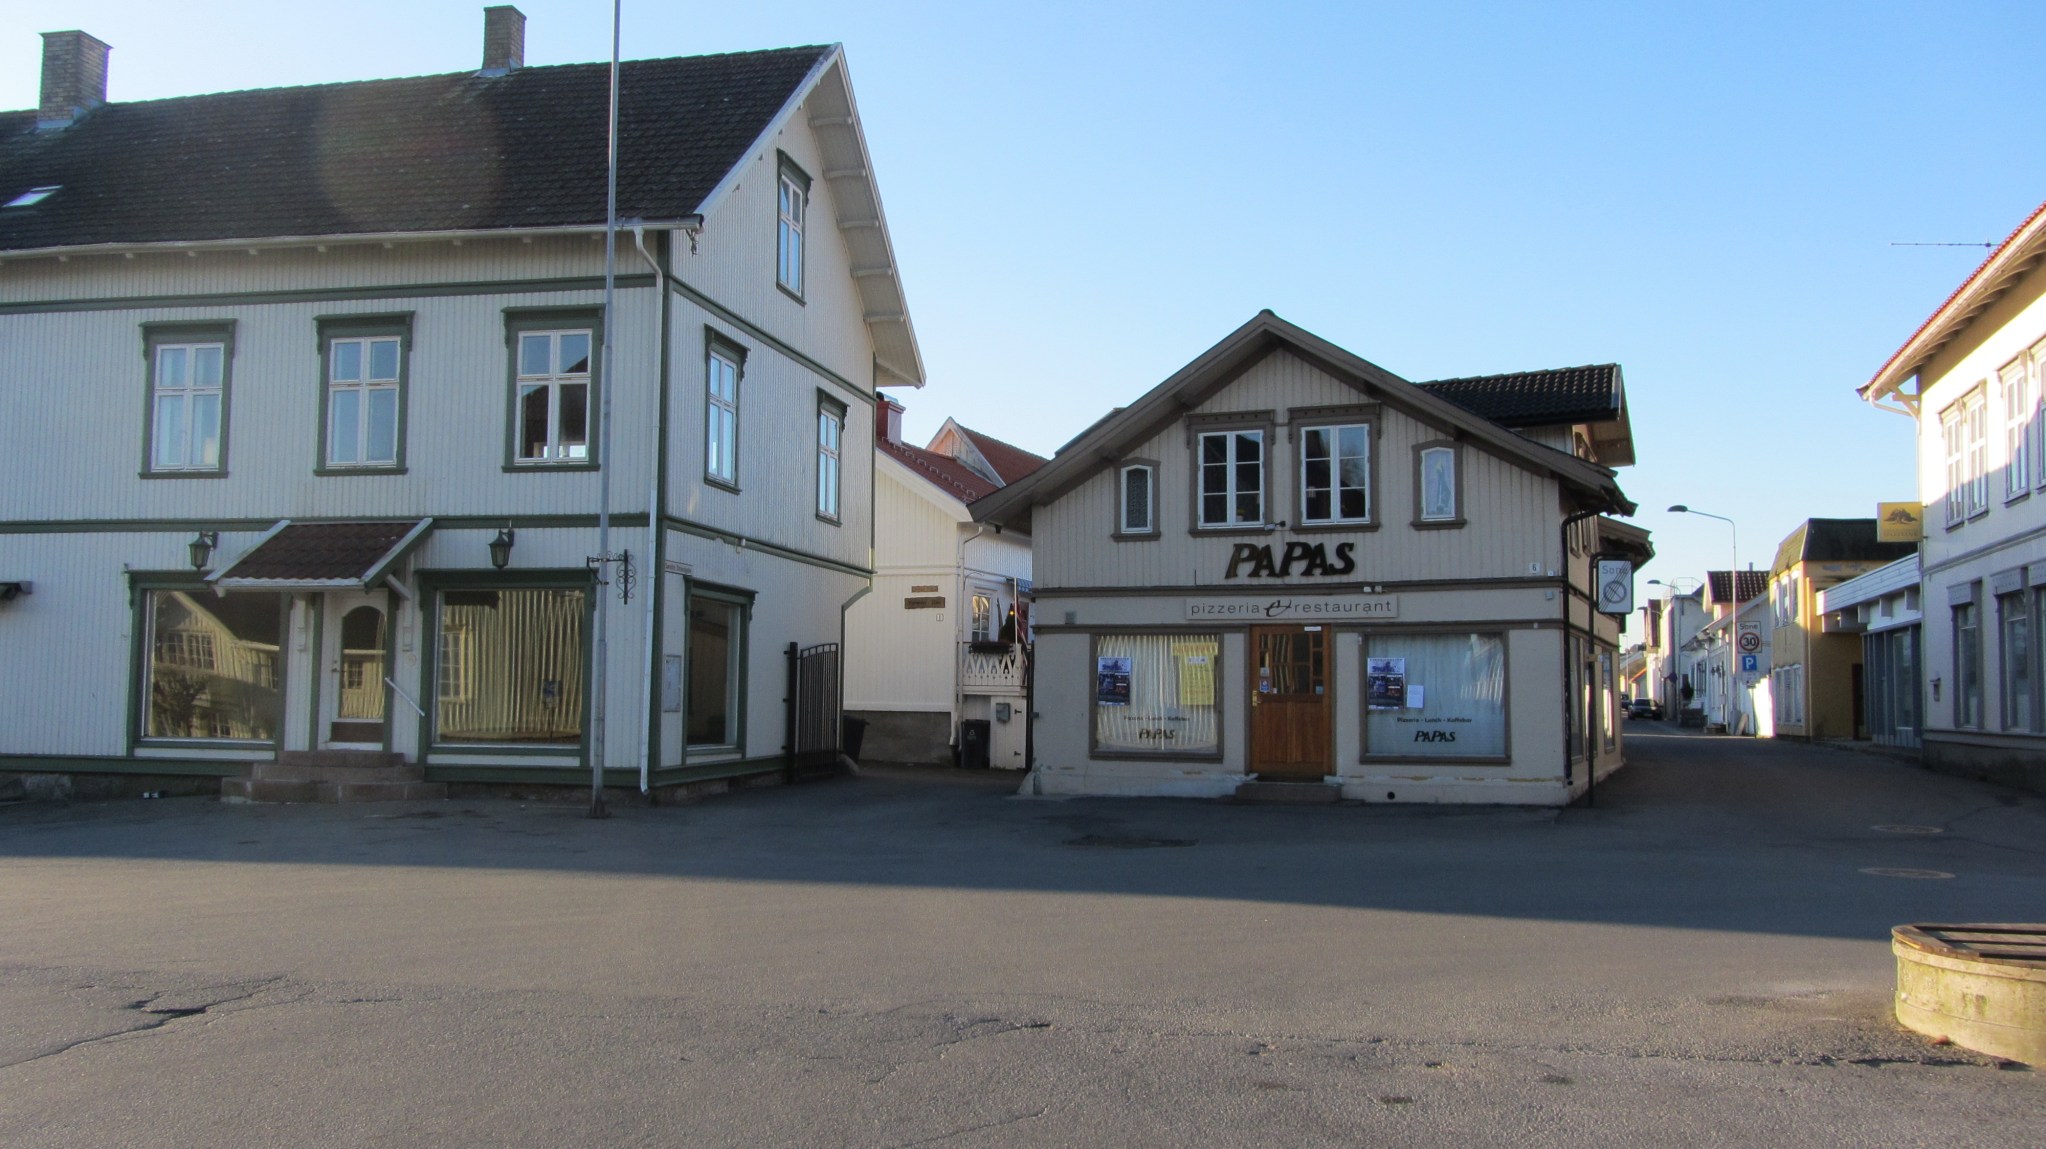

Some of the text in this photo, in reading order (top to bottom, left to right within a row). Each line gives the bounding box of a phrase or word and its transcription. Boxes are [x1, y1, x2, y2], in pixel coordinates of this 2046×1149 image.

[1225, 541, 1355, 579] PAPAS
[1191, 602, 1260, 616] pizzeria
[1294, 601, 1392, 613] restaurant
[1743, 637, 1757, 647] 30
[1745, 657, 1754, 670] P
[1414, 730, 1456, 742] PAPAS
